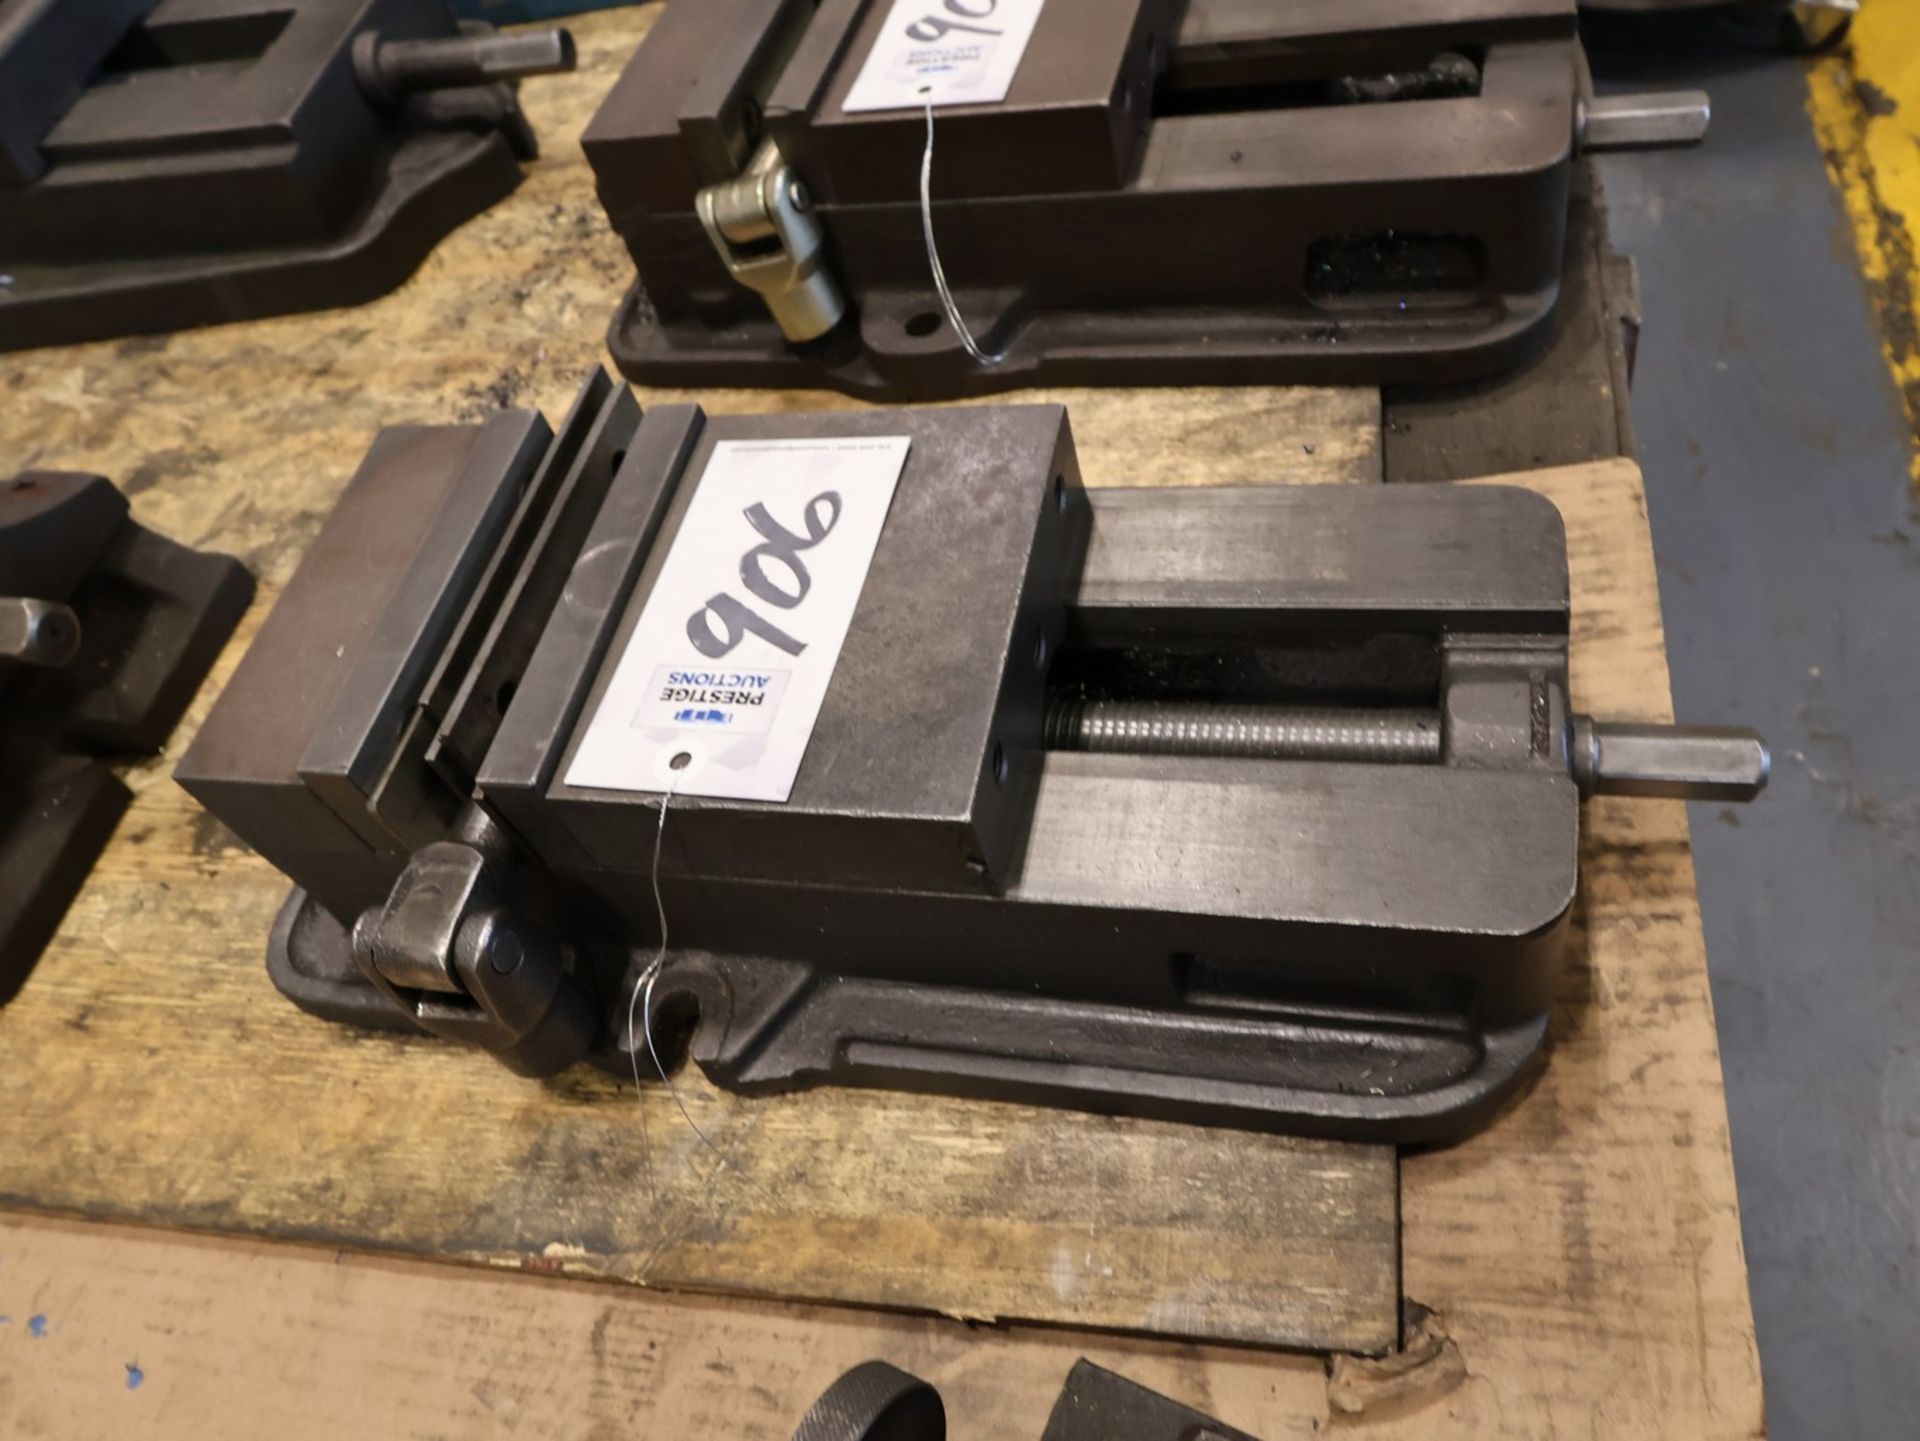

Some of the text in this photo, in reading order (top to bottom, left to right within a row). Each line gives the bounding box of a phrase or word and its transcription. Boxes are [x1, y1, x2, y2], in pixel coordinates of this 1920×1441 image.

[686, 490, 843, 660] 906
[668, 671, 771, 688] AUCTIONS
[660, 687, 765, 706] PRESTIGE
